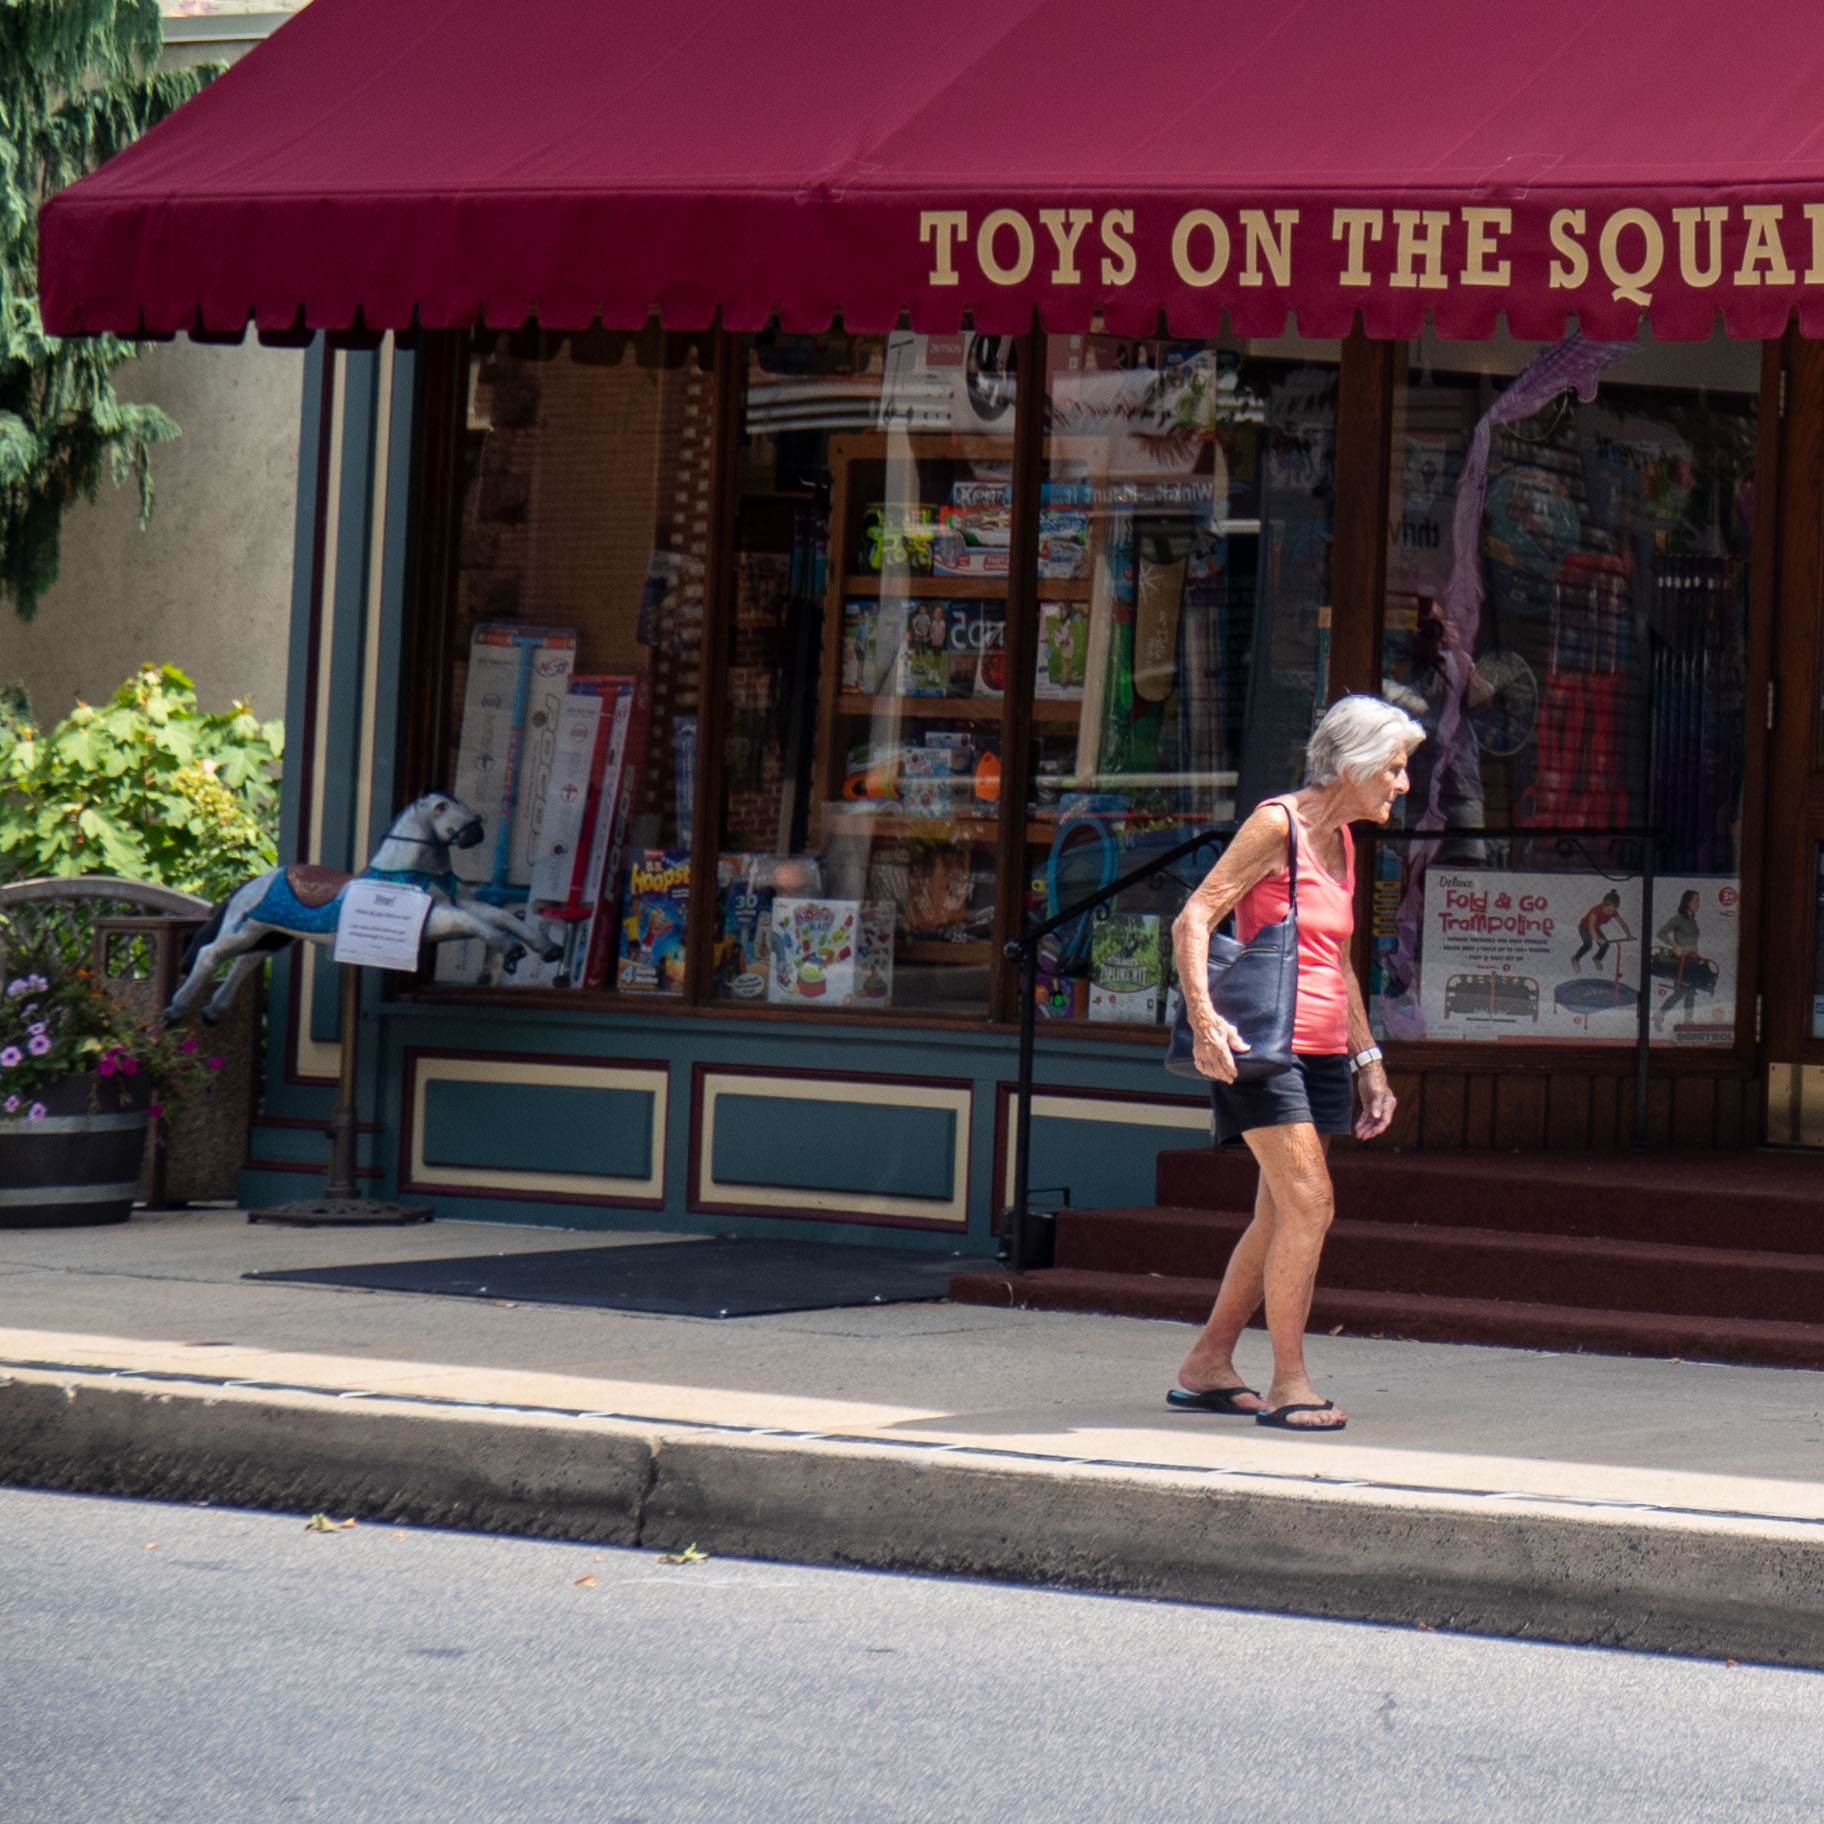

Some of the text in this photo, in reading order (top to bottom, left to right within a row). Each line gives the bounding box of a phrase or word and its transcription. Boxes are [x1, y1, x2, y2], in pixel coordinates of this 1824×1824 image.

[918, 208, 1138, 287] TOYS
[1171, 207, 1299, 287] ON
[1332, 205, 1513, 289] THE
[735, 894, 758, 909] 30
[1446, 889, 1488, 912] Fold
[1495, 892, 1511, 910] &
[1438, 912, 1555, 936] Trampoline
